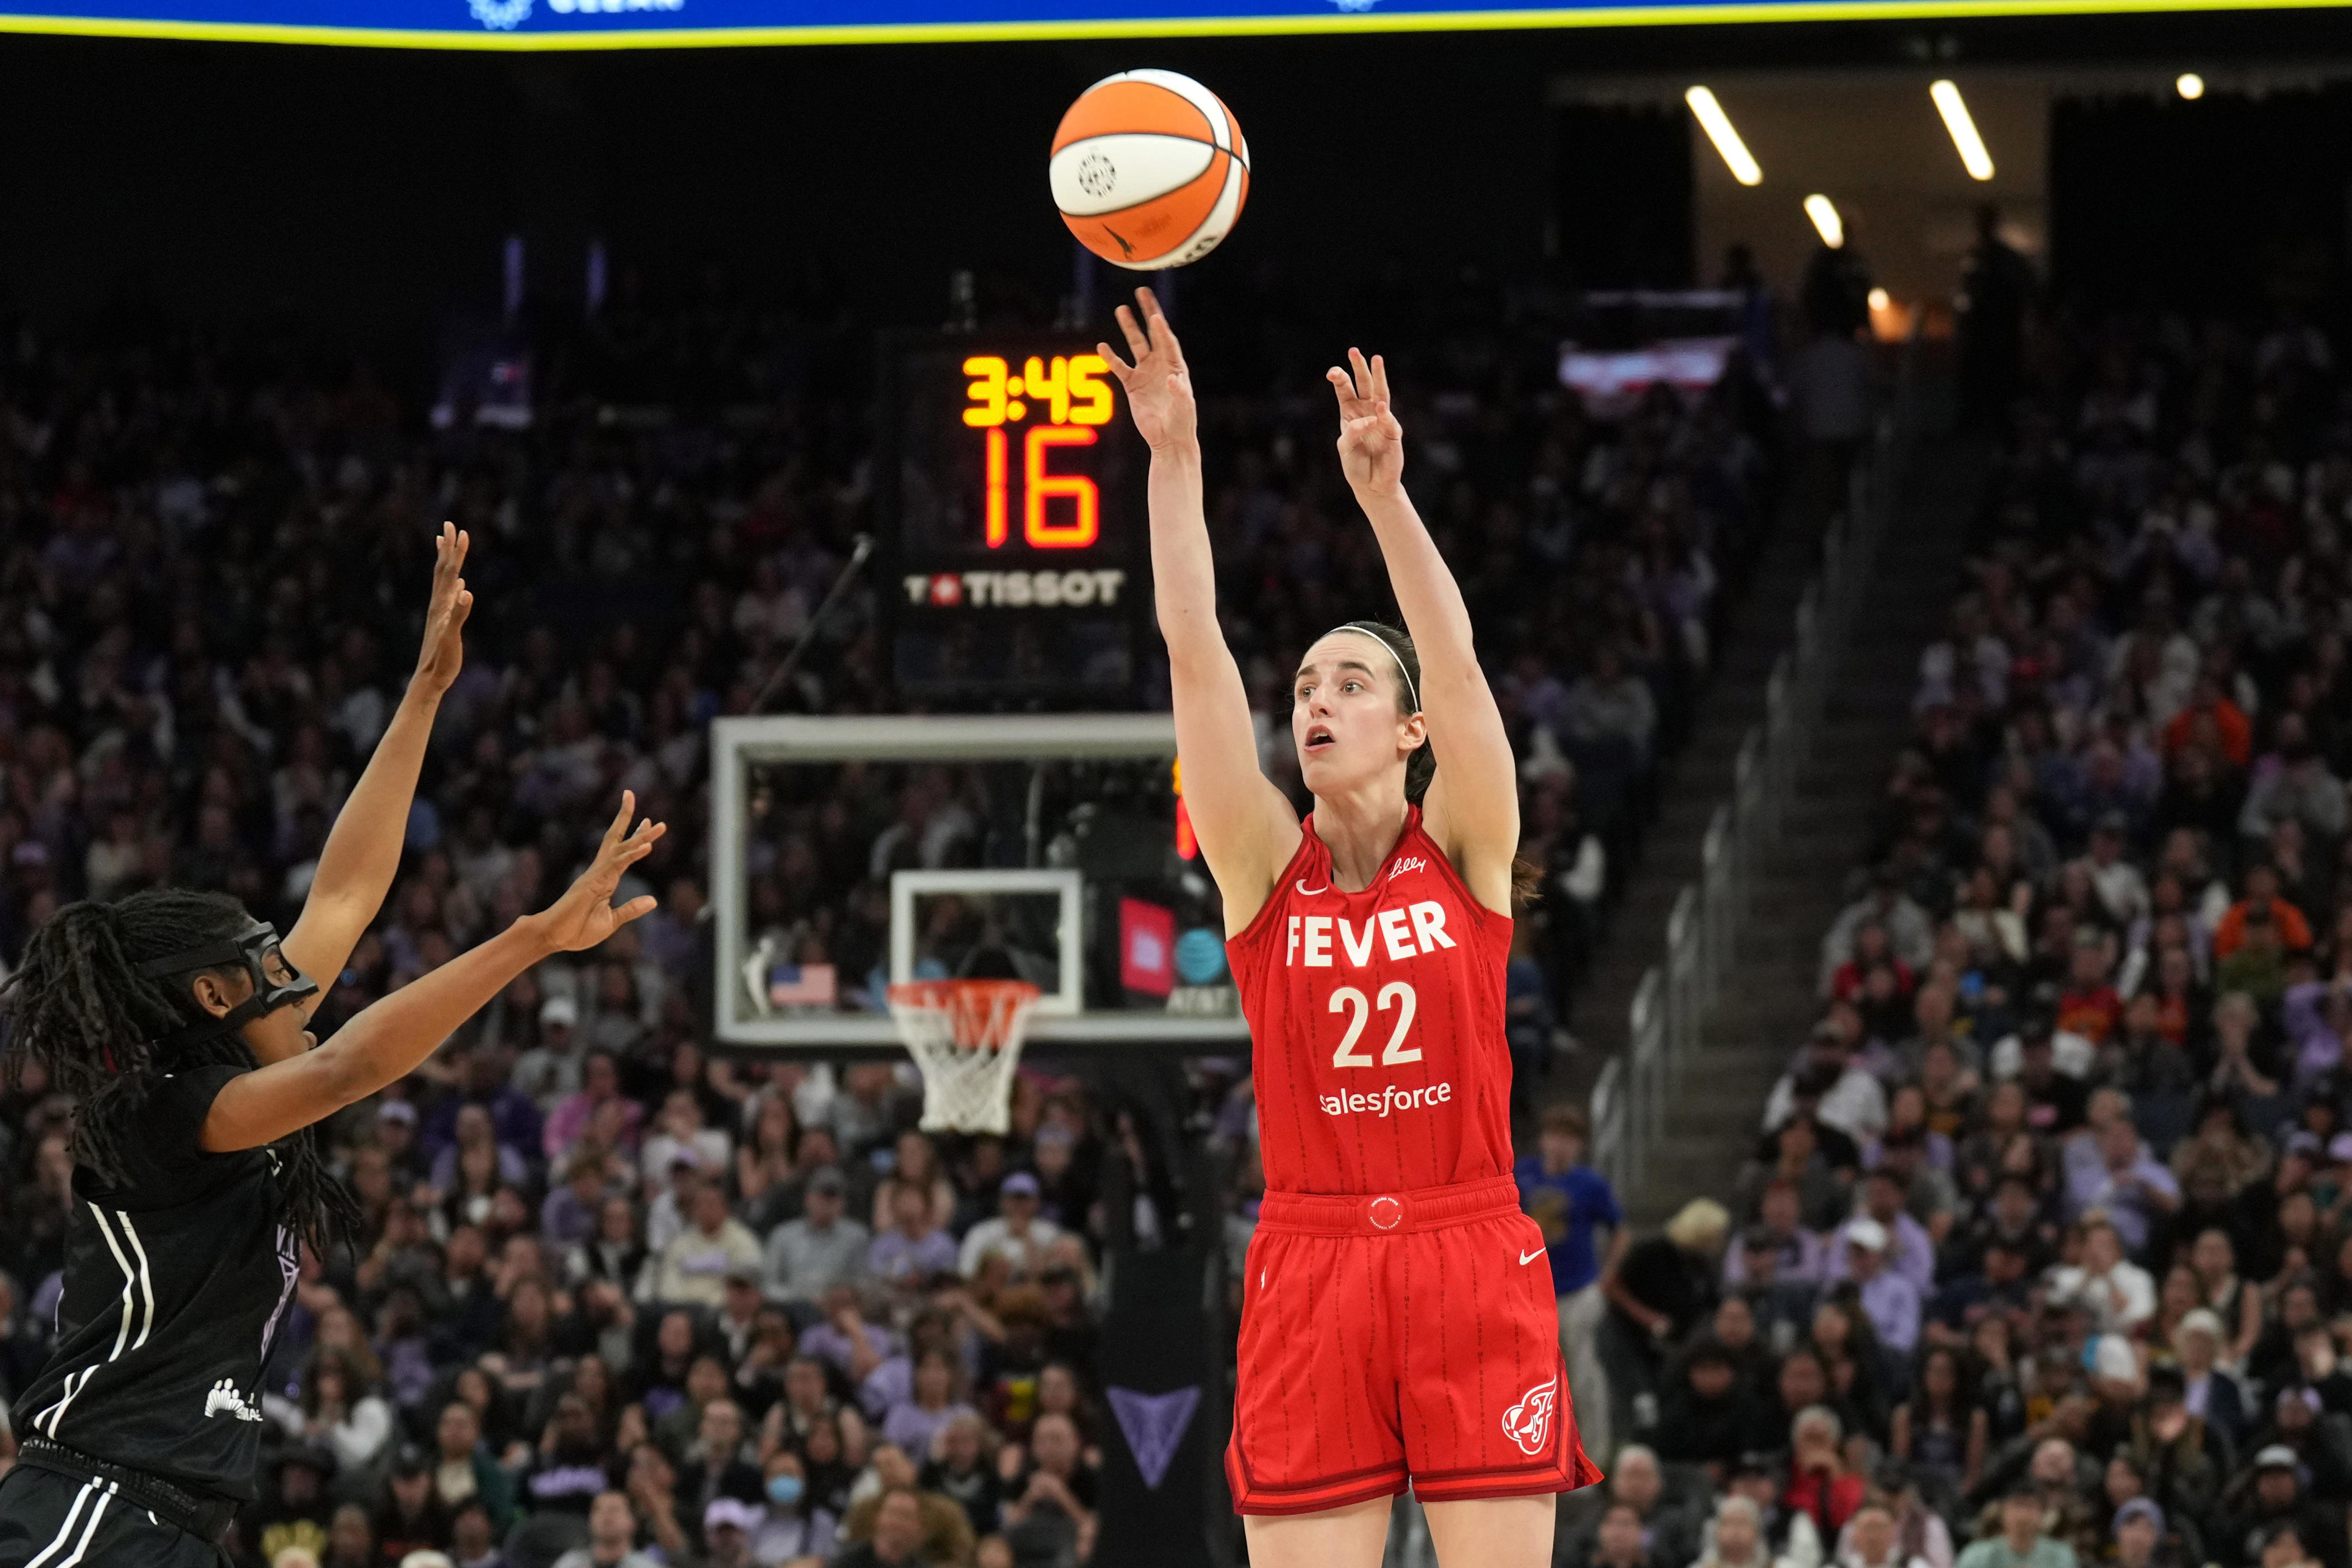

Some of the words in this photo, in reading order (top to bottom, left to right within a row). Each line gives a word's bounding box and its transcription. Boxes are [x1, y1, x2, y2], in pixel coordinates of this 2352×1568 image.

[963, 355, 1113, 427] 3:45
[986, 424, 1099, 549] 16
[962, 569, 1126, 607] TISSOT
[1286, 900, 1457, 967] FEVER
[1329, 980, 1423, 1069] 22
